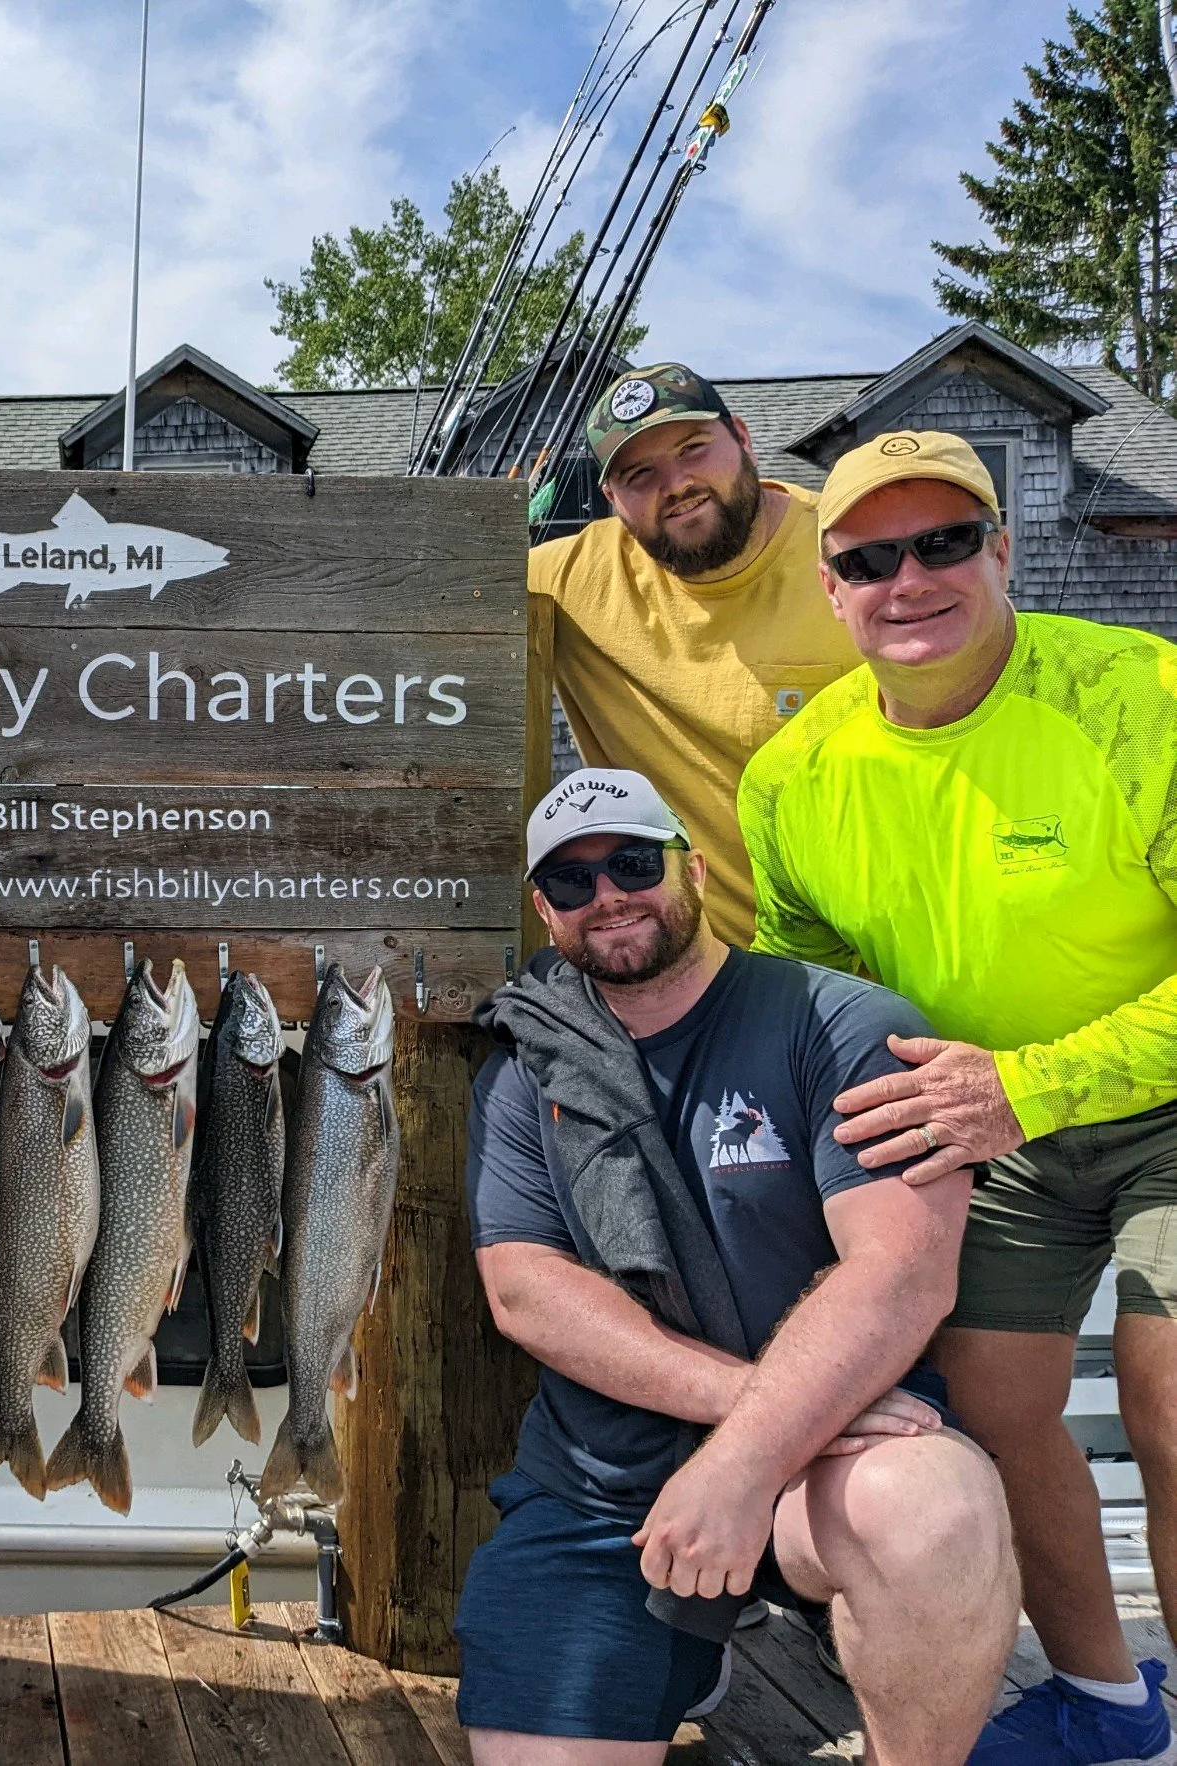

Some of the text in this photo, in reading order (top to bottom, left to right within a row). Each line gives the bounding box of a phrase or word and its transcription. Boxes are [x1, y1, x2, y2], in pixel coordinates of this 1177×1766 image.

[622, 398, 650, 417] DAVIS
[3, 542, 164, 574] Leland, MI
[78, 651, 467, 726] Charters
[544, 780, 628, 820] Callaway
[50, 802, 270, 838] Stephenson
